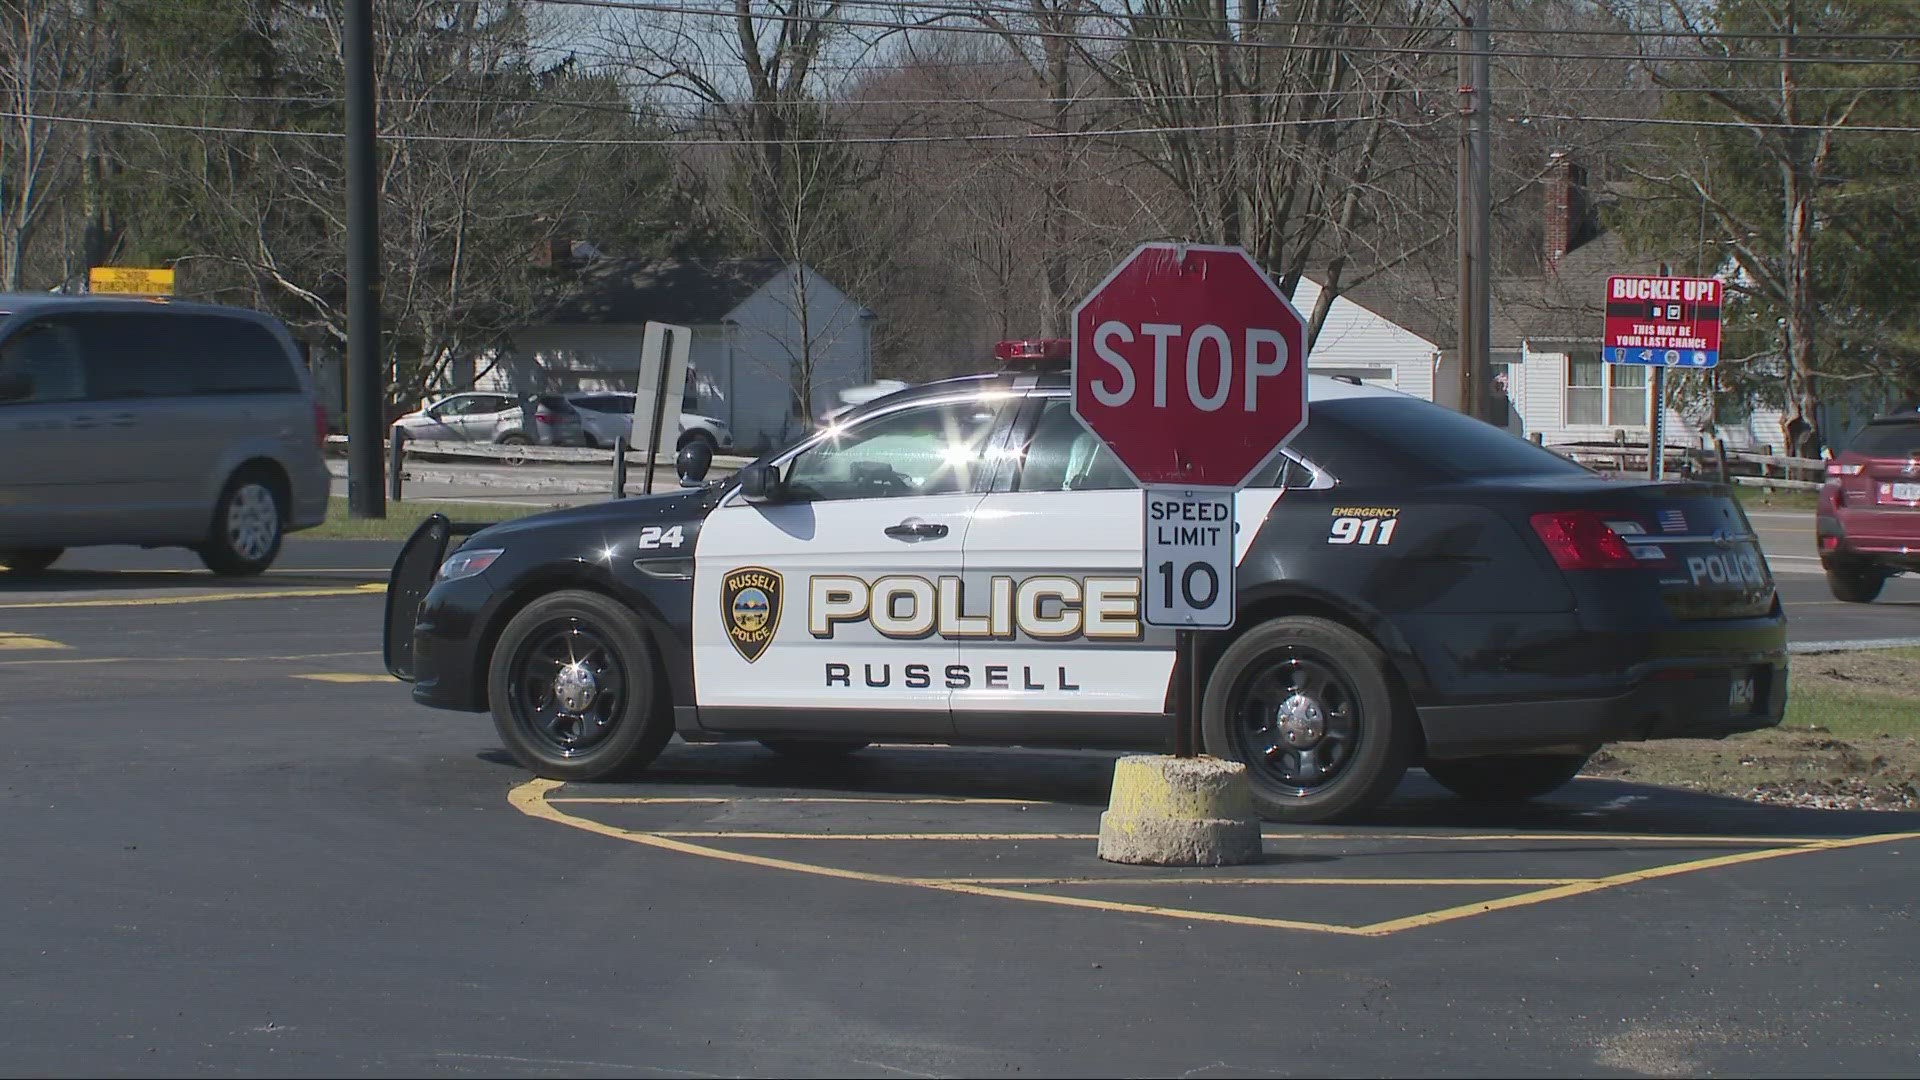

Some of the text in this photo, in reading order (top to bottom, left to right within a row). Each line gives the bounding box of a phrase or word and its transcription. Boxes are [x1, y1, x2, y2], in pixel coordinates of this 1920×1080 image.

[1612, 278, 1715, 301] BUCKLE UP!
[1632, 324, 1692, 337] THIS MAY BE
[1616, 335, 1707, 349] YOUR LAST CHANCE
[1090, 319, 1289, 413] STOP
[1151, 501, 1229, 522] SPEED
[1331, 507, 1400, 517] EMERGENCY
[638, 525, 685, 549] 24
[1157, 526, 1221, 546] LIMIT
[1327, 516, 1398, 545] 911
[728, 574, 776, 593] RUSSELL
[1158, 560, 1220, 610] 10
[808, 574, 1141, 640] POLICE
[731, 626, 770, 642] POLICE
[825, 662, 1080, 690] RUSSELL
